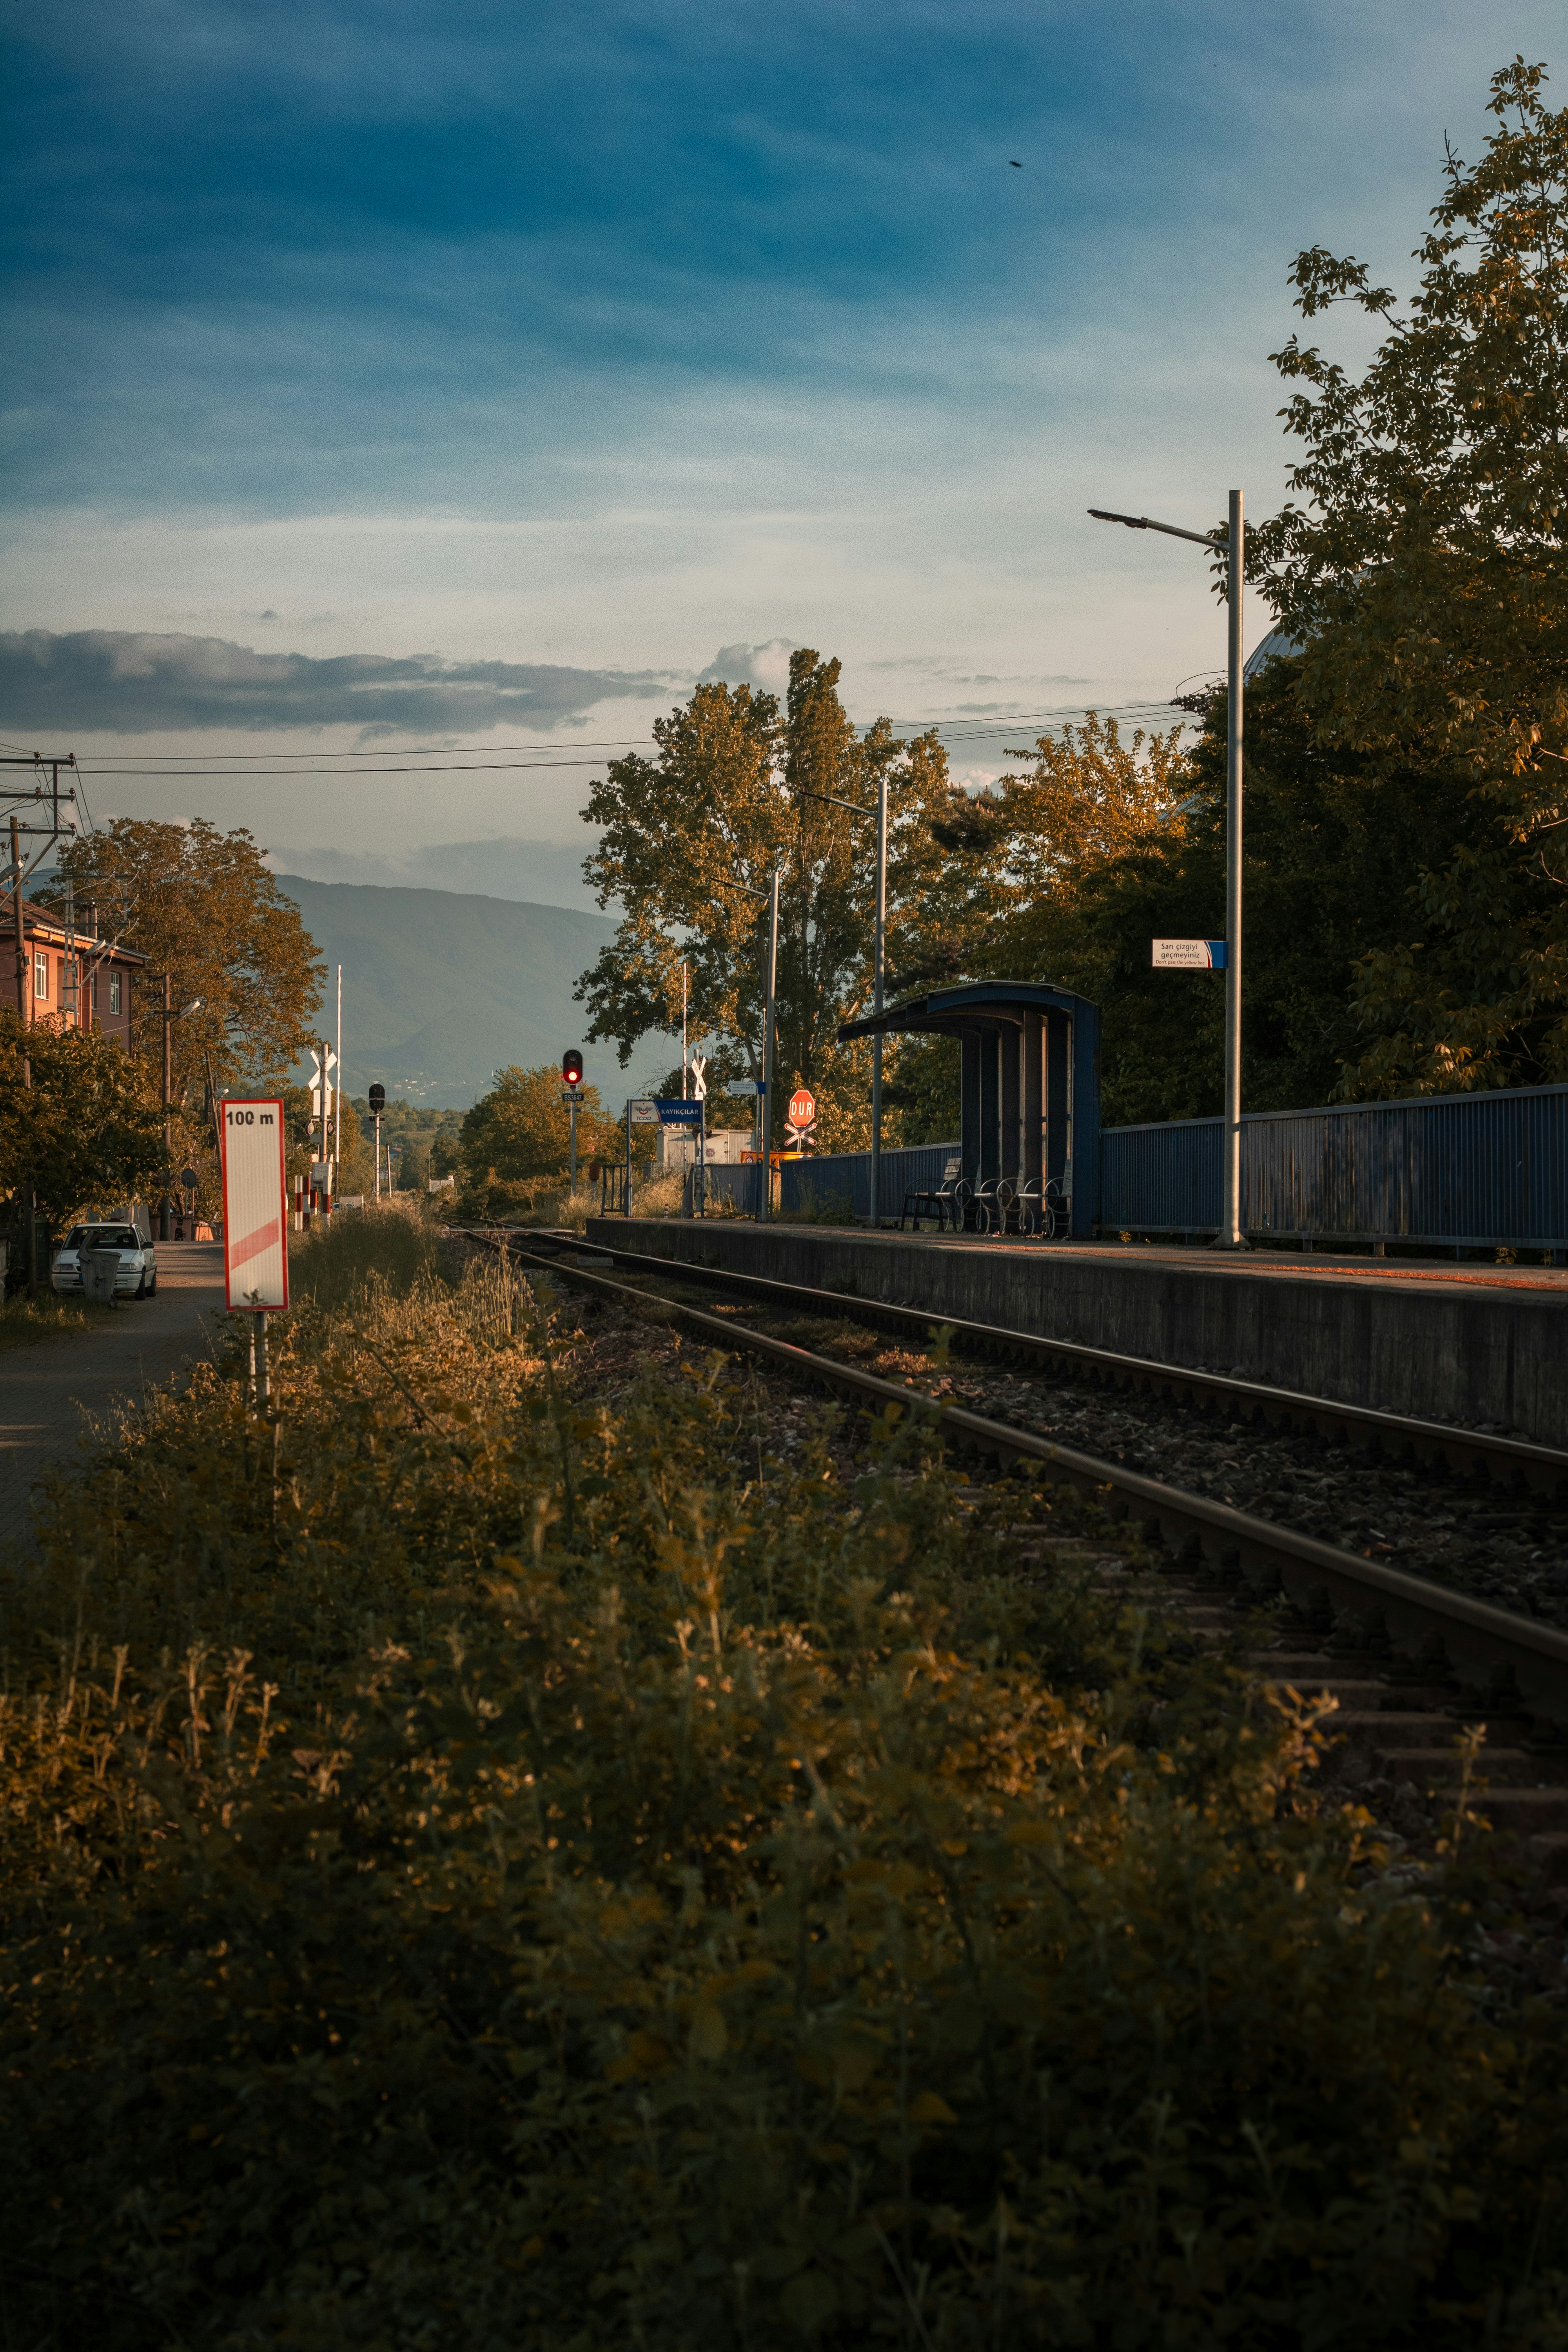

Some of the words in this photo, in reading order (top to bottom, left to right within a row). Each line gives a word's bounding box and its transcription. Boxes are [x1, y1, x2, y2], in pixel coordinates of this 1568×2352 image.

[791, 1102, 812, 1116] DUR
[226, 1111, 254, 1125] 100
[260, 1114, 273, 1124] m
